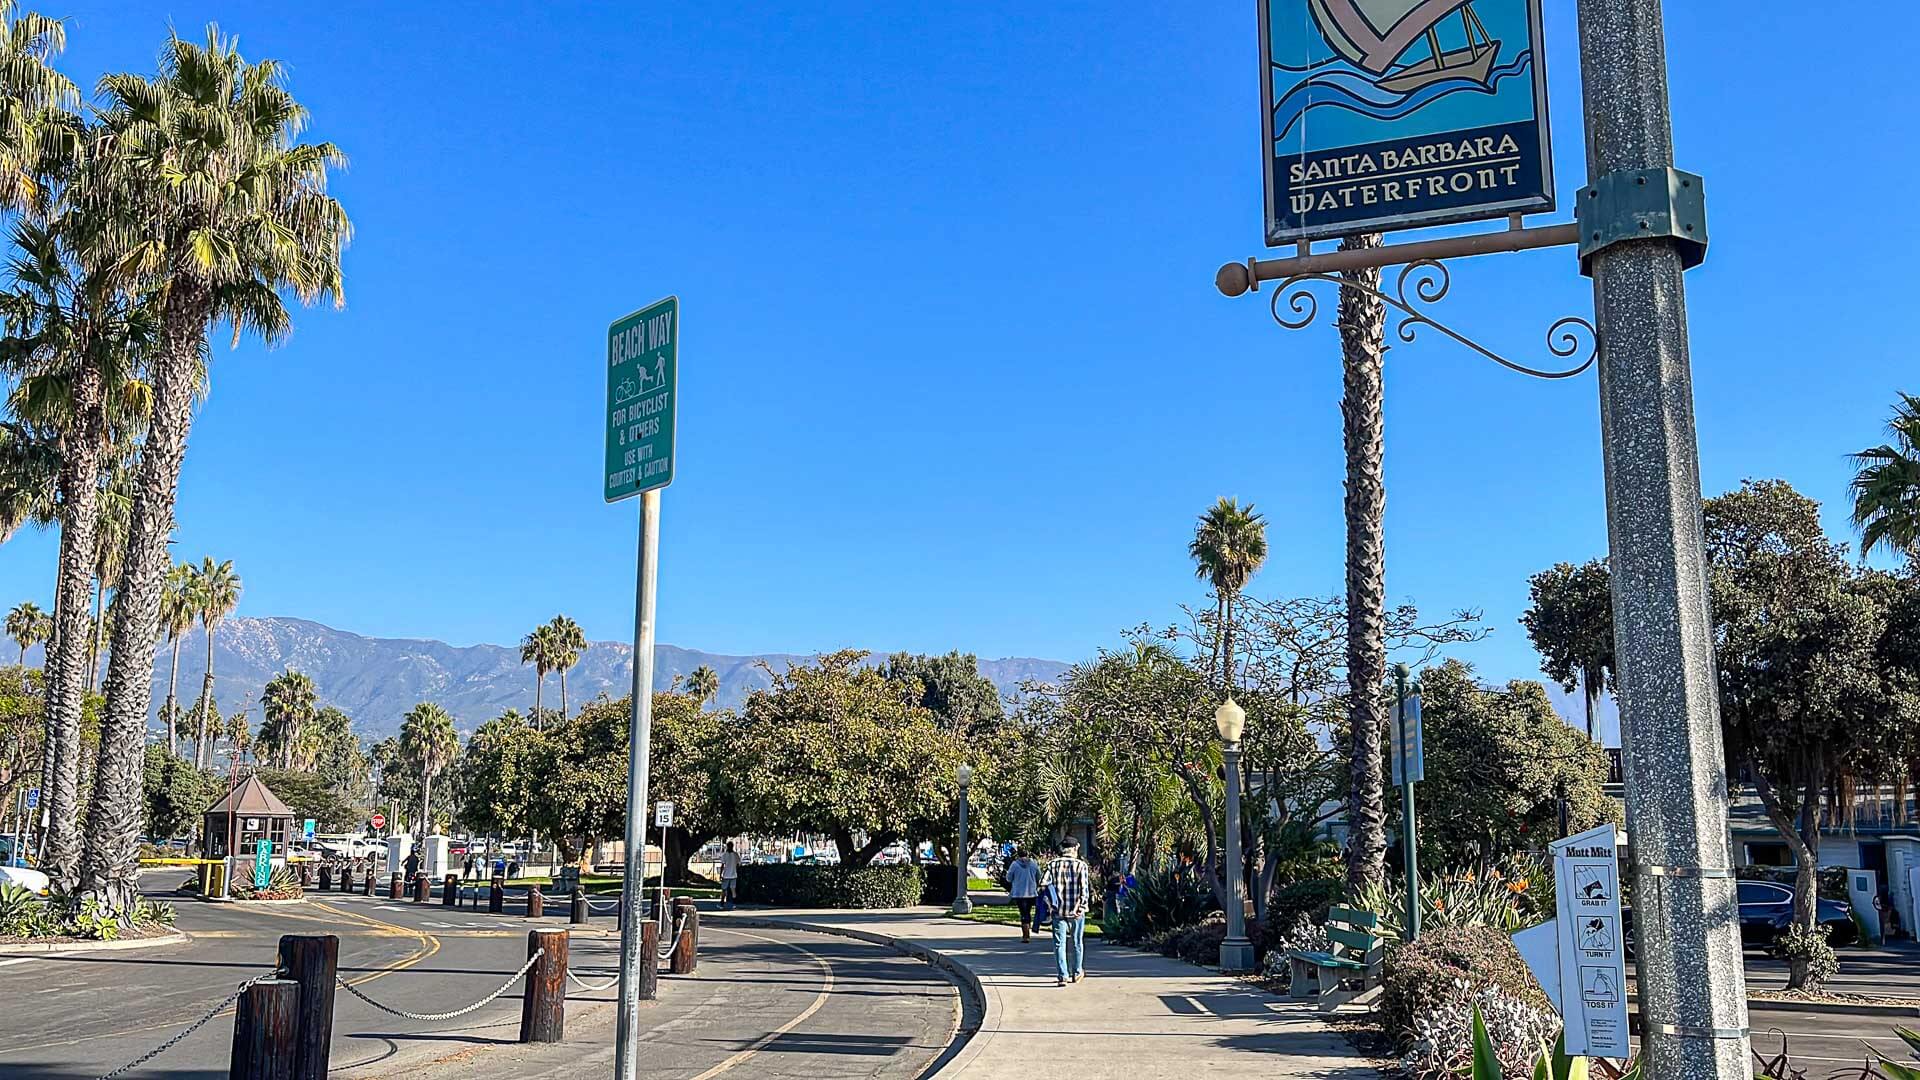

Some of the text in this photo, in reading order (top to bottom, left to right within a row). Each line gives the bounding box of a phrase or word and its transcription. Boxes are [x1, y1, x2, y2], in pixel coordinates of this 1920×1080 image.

[1289, 134, 1519, 183] SANTA BARBARA
[1289, 164, 1520, 214] WATERFRONT
[612, 310, 672, 367] BEACH WAY
[612, 392, 669, 428] FOR BICYCLIST
[619, 416, 660, 446] & OTHERS
[624, 443, 653, 466] USE WITH
[609, 467, 636, 488] COURTESY
[644, 457, 668, 478] CAUTION
[659, 814, 669, 822] 15
[257, 841, 267, 885] PARKING
[1565, 846, 1613, 858] Mutt Mitt
[1585, 951, 1612, 959] TURN IT
[1586, 1001, 1606, 1009] TOSS
